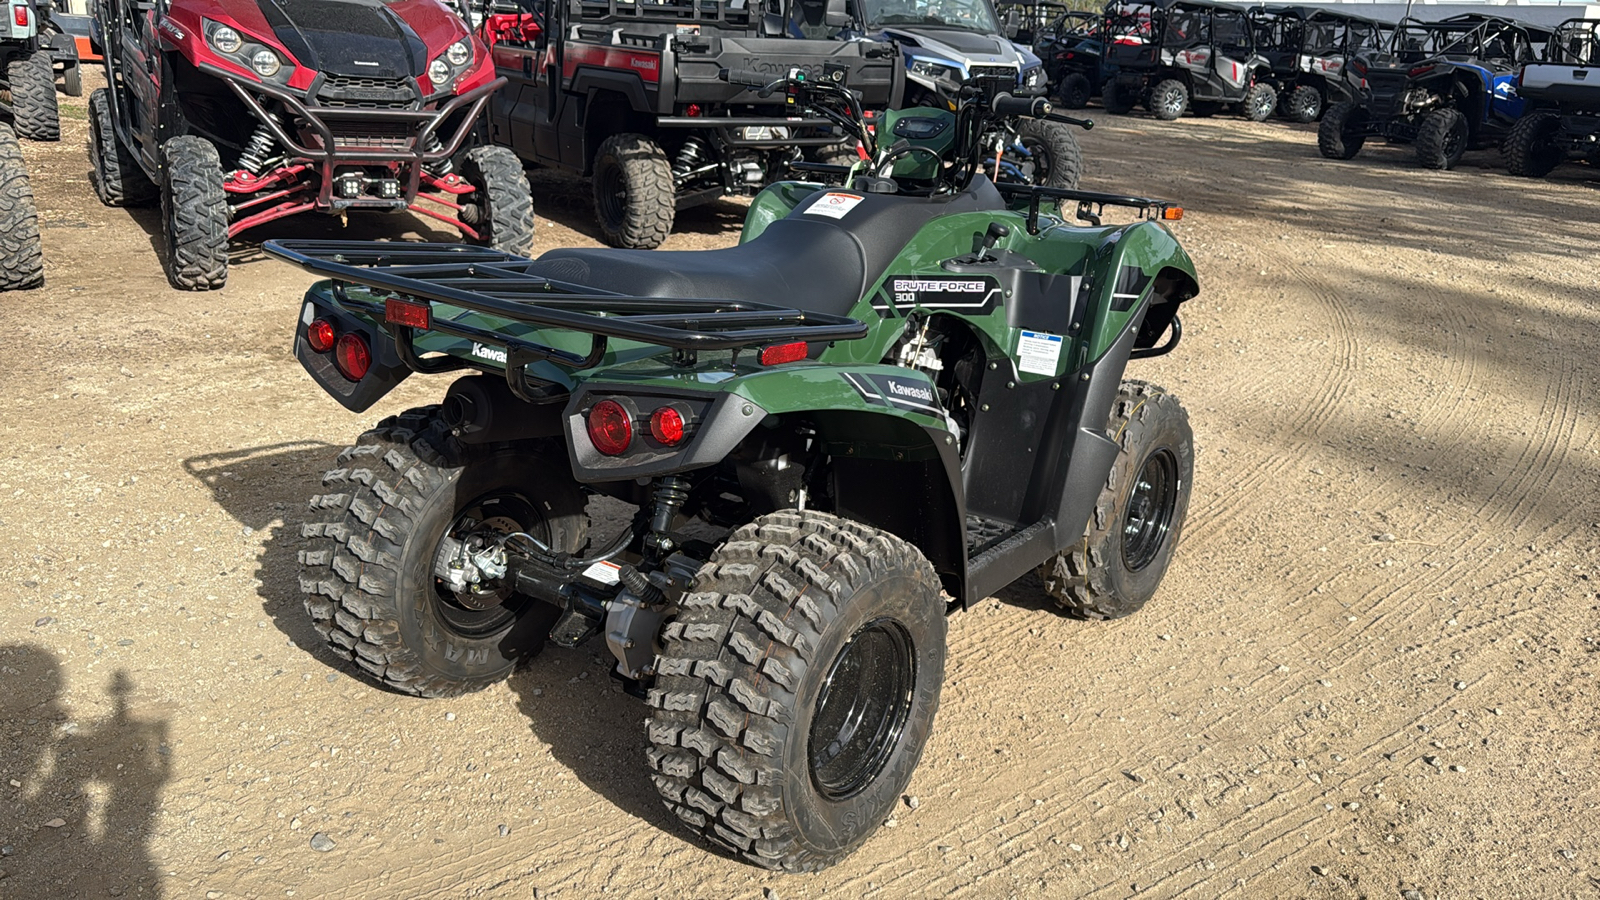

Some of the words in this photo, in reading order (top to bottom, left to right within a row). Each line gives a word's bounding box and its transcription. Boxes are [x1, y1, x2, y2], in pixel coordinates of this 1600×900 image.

[631, 58, 657, 70] Kawasaki
[893, 279, 938, 292] BRUTE
[938, 280, 986, 293] FORCE
[895, 292, 915, 302] 300
[471, 341, 508, 364] Kawas
[887, 380, 934, 402] Kawasaki
